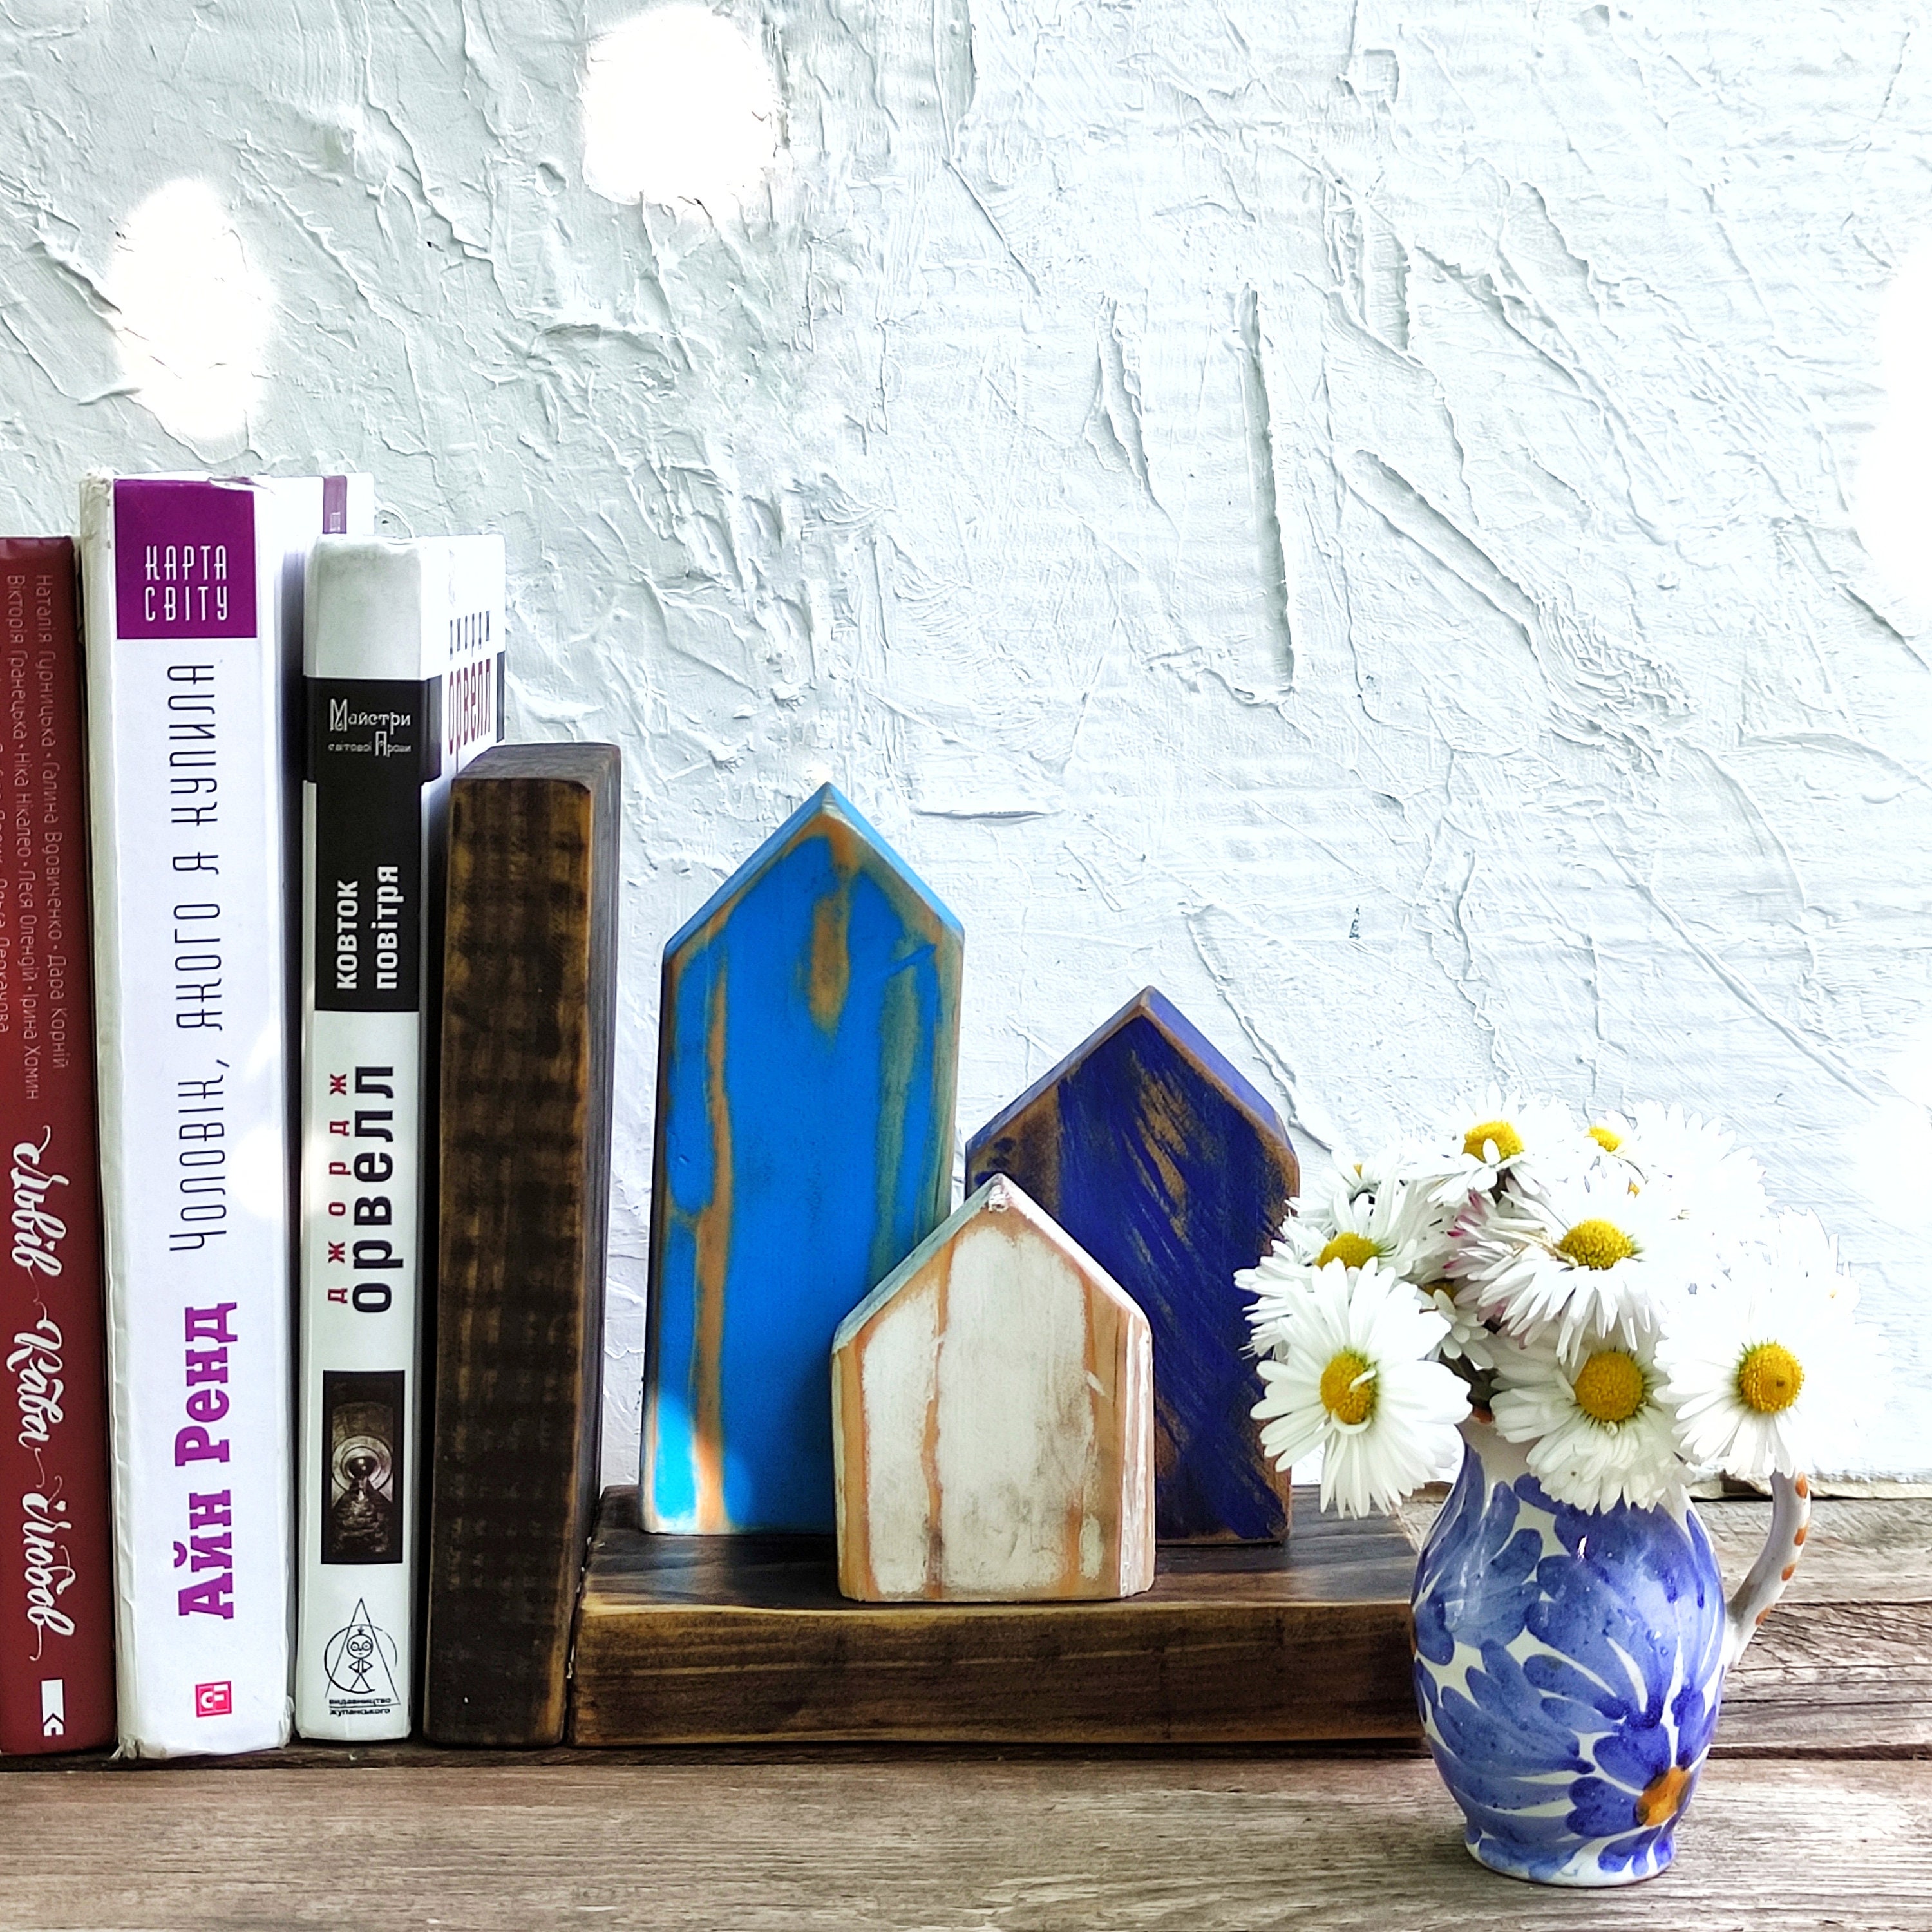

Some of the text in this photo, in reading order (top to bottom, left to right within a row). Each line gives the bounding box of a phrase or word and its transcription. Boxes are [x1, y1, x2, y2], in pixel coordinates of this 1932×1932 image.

[145, 545, 227, 580] КАРТА
[145, 586, 228, 621] СВІТУ
[330, 698, 411, 735] Майстри
[6, 574, 41, 1100] Вікторія Гранецька Ніка Нікалео Леся Олендій Ірина Хомин
[35, 574, 71, 1068] Наталія Гурницька Галина Вдовиченко Дара Корній
[167, 665, 230, 1251] ЧОЛОВІК, ЯКОГО Я КУПИЛА
[337, 880, 359, 989] ковток
[370, 866, 405, 989] повітря
[173, 1302, 238, 1620] Айн Ренд
